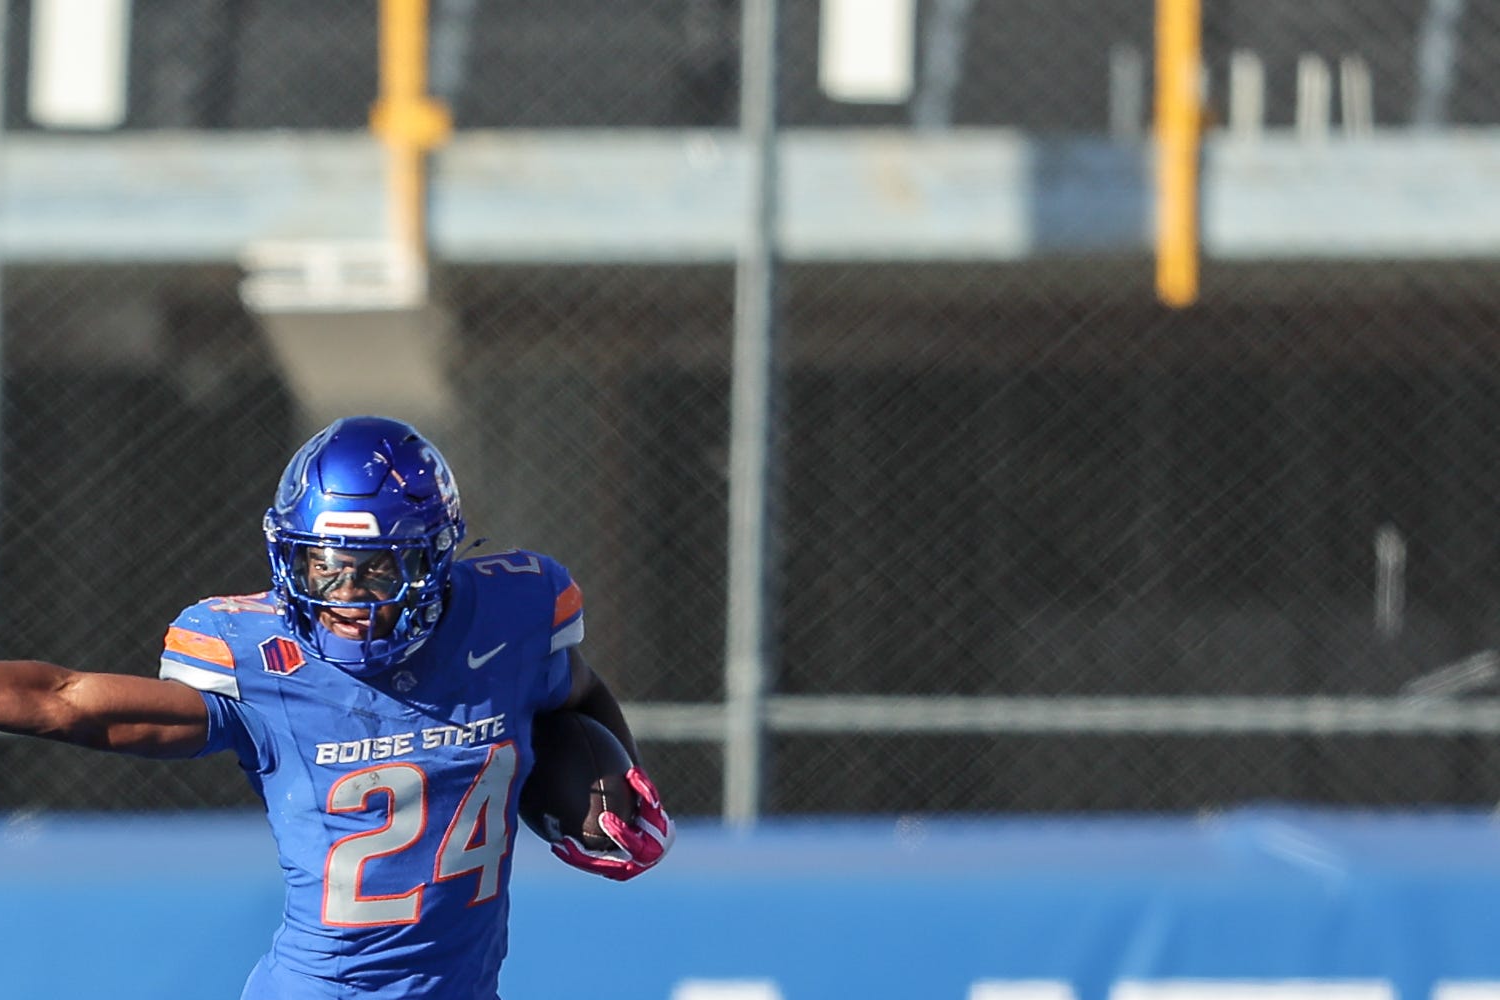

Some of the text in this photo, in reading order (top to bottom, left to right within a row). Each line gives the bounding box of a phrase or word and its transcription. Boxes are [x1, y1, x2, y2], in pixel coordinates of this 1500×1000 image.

[315, 713, 506, 765] BOISE STATE
[321, 739, 520, 928] 24
